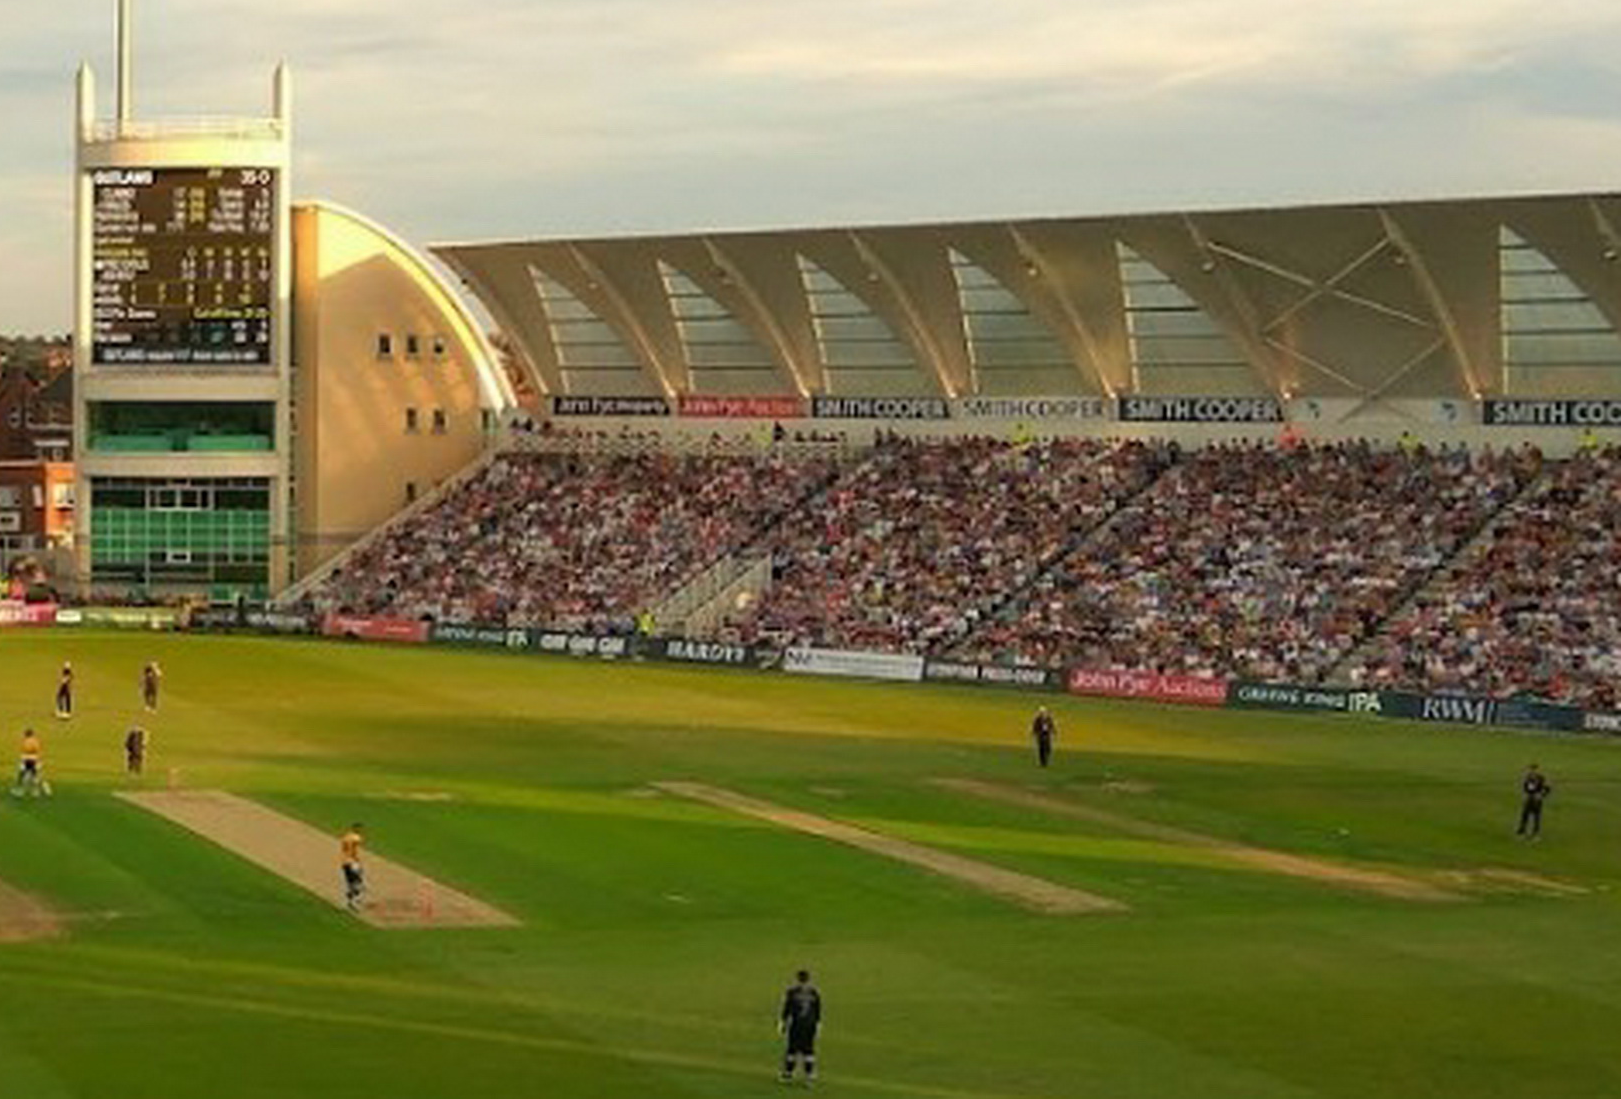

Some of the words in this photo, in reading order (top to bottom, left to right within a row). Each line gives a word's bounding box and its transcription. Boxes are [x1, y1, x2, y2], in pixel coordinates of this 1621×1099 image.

[876, 400, 947, 417] COOPER
[1023, 401, 1102, 418] COOPER
[1128, 401, 1190, 420] SMITH
[1194, 401, 1278, 420] COOPER
[1492, 403, 1567, 423] SMITH
[1070, 670, 1116, 689] John
[1118, 675, 1149, 694] Pye
[1153, 676, 1227, 699] Auctions
[1348, 692, 1382, 712] IPA
[1422, 698, 1485, 724] RWM
